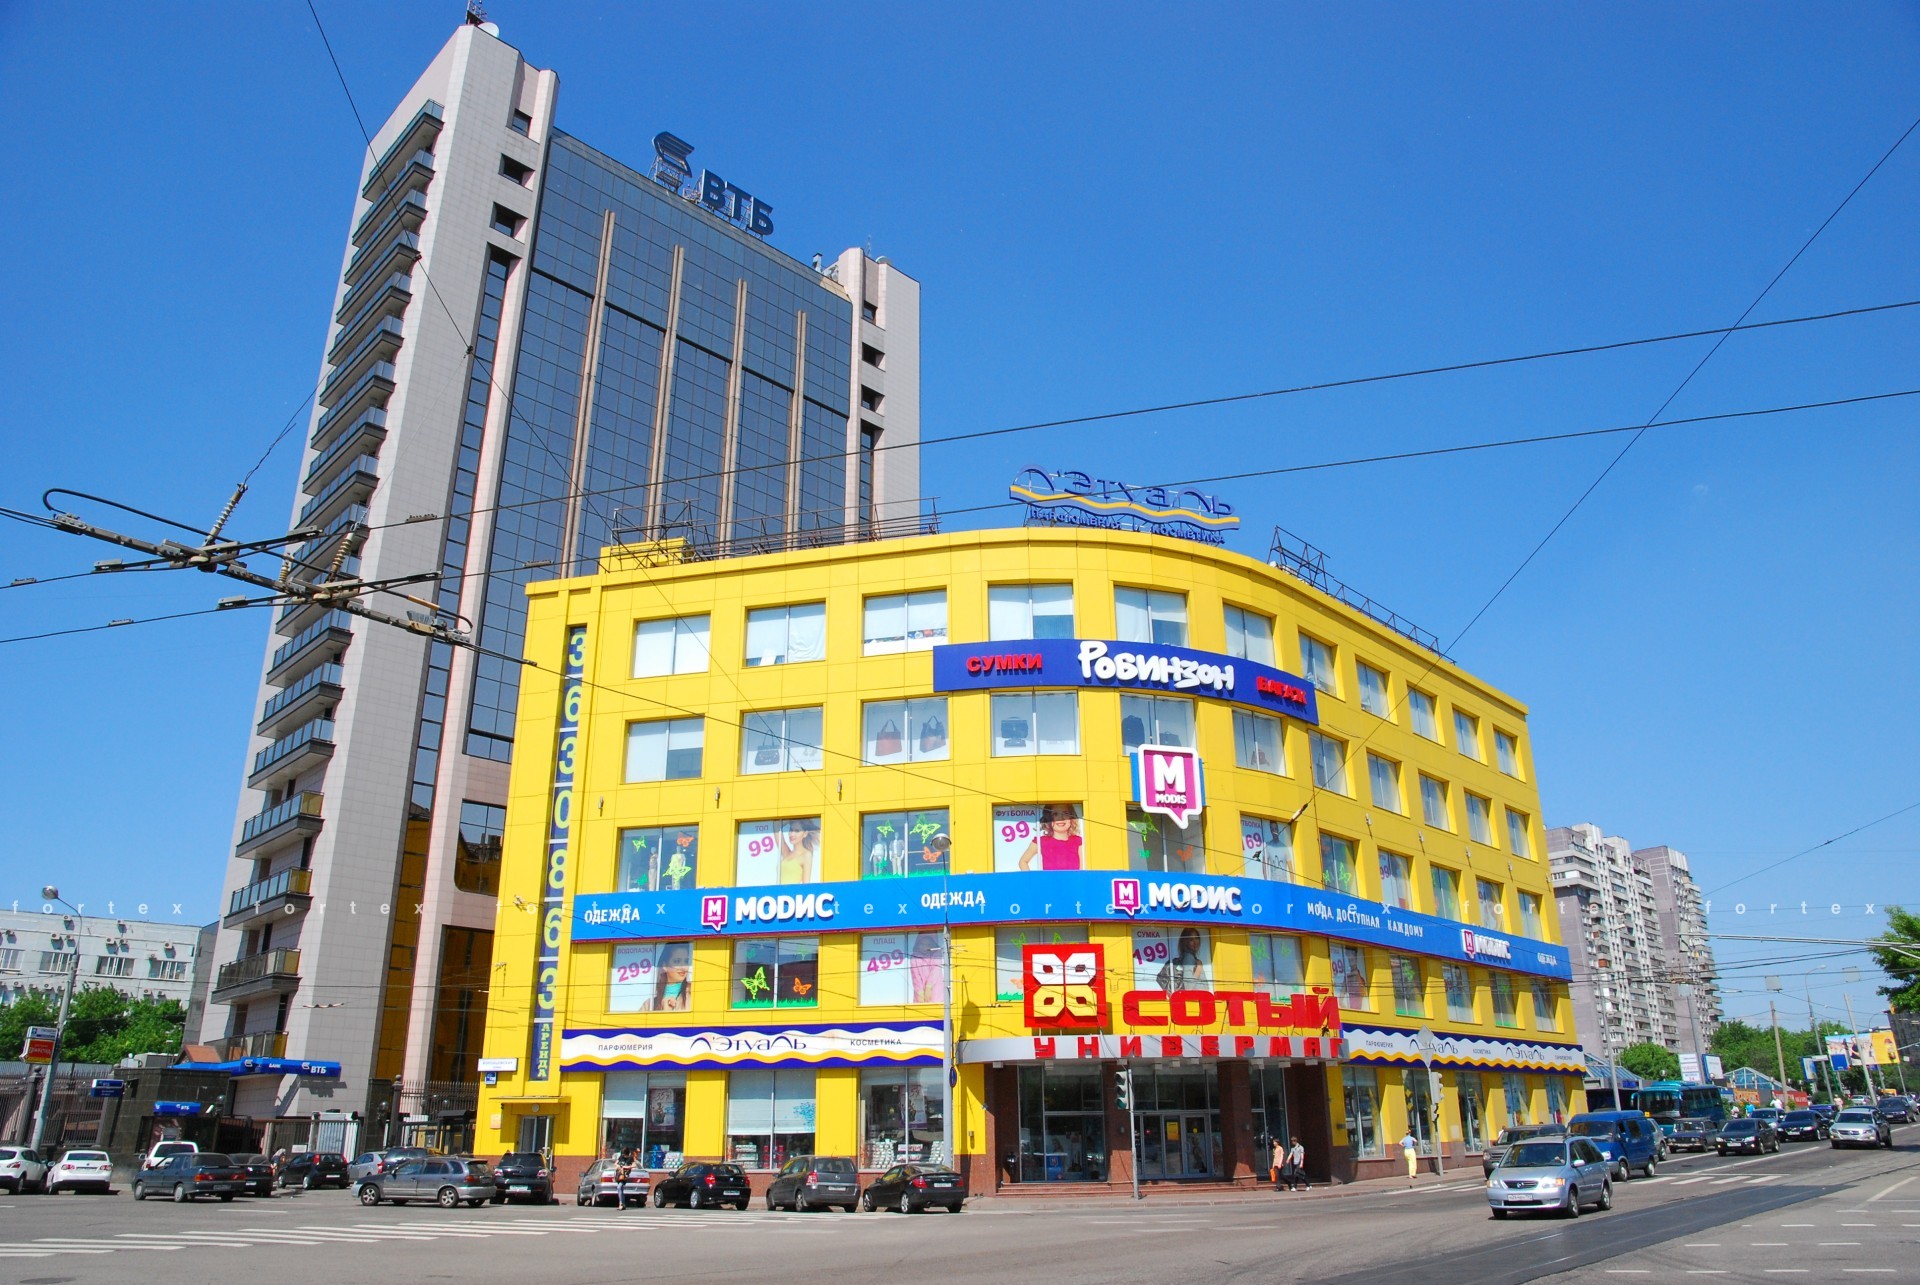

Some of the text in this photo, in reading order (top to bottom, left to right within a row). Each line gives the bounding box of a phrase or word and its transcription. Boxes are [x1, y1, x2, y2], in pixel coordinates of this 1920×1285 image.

[700, 168, 775, 236] ВТБ
[966, 653, 1042, 672] СУМКИ
[1256, 675, 1306, 704] БАГАЖ
[1153, 754, 1186, 792] M
[1155, 793, 1187, 805] MODIS
[995, 809, 1036, 817] ФУТБОЛКА
[1001, 820, 1030, 843] 99
[748, 835, 775, 857] 99
[921, 891, 986, 910] ОДЕЖДА
[584, 906, 641, 925] ОДЕЖДА
[1336, 908, 1380, 928] ДОСТУПНАЯ
[1388, 919, 1424, 938] КАЖДОМУ
[873, 937, 896, 946] ПЛАЩ
[1136, 930, 1161, 938] СУМКА
[867, 948, 905, 973] 499
[1133, 942, 1168, 965] 199
[617, 958, 652, 984] 299
[1122, 986, 1340, 1030] СОТЫЙ
[537, 1023, 551, 1077] АРЕНДА
[598, 1043, 653, 1052] ПАРФЮМЕРИЯ
[850, 1038, 902, 1047] КОСМЕТИКА
[1033, 1034, 1344, 1059] УНИВЕРМАГ
[310, 1066, 327, 1074] ВТБ
